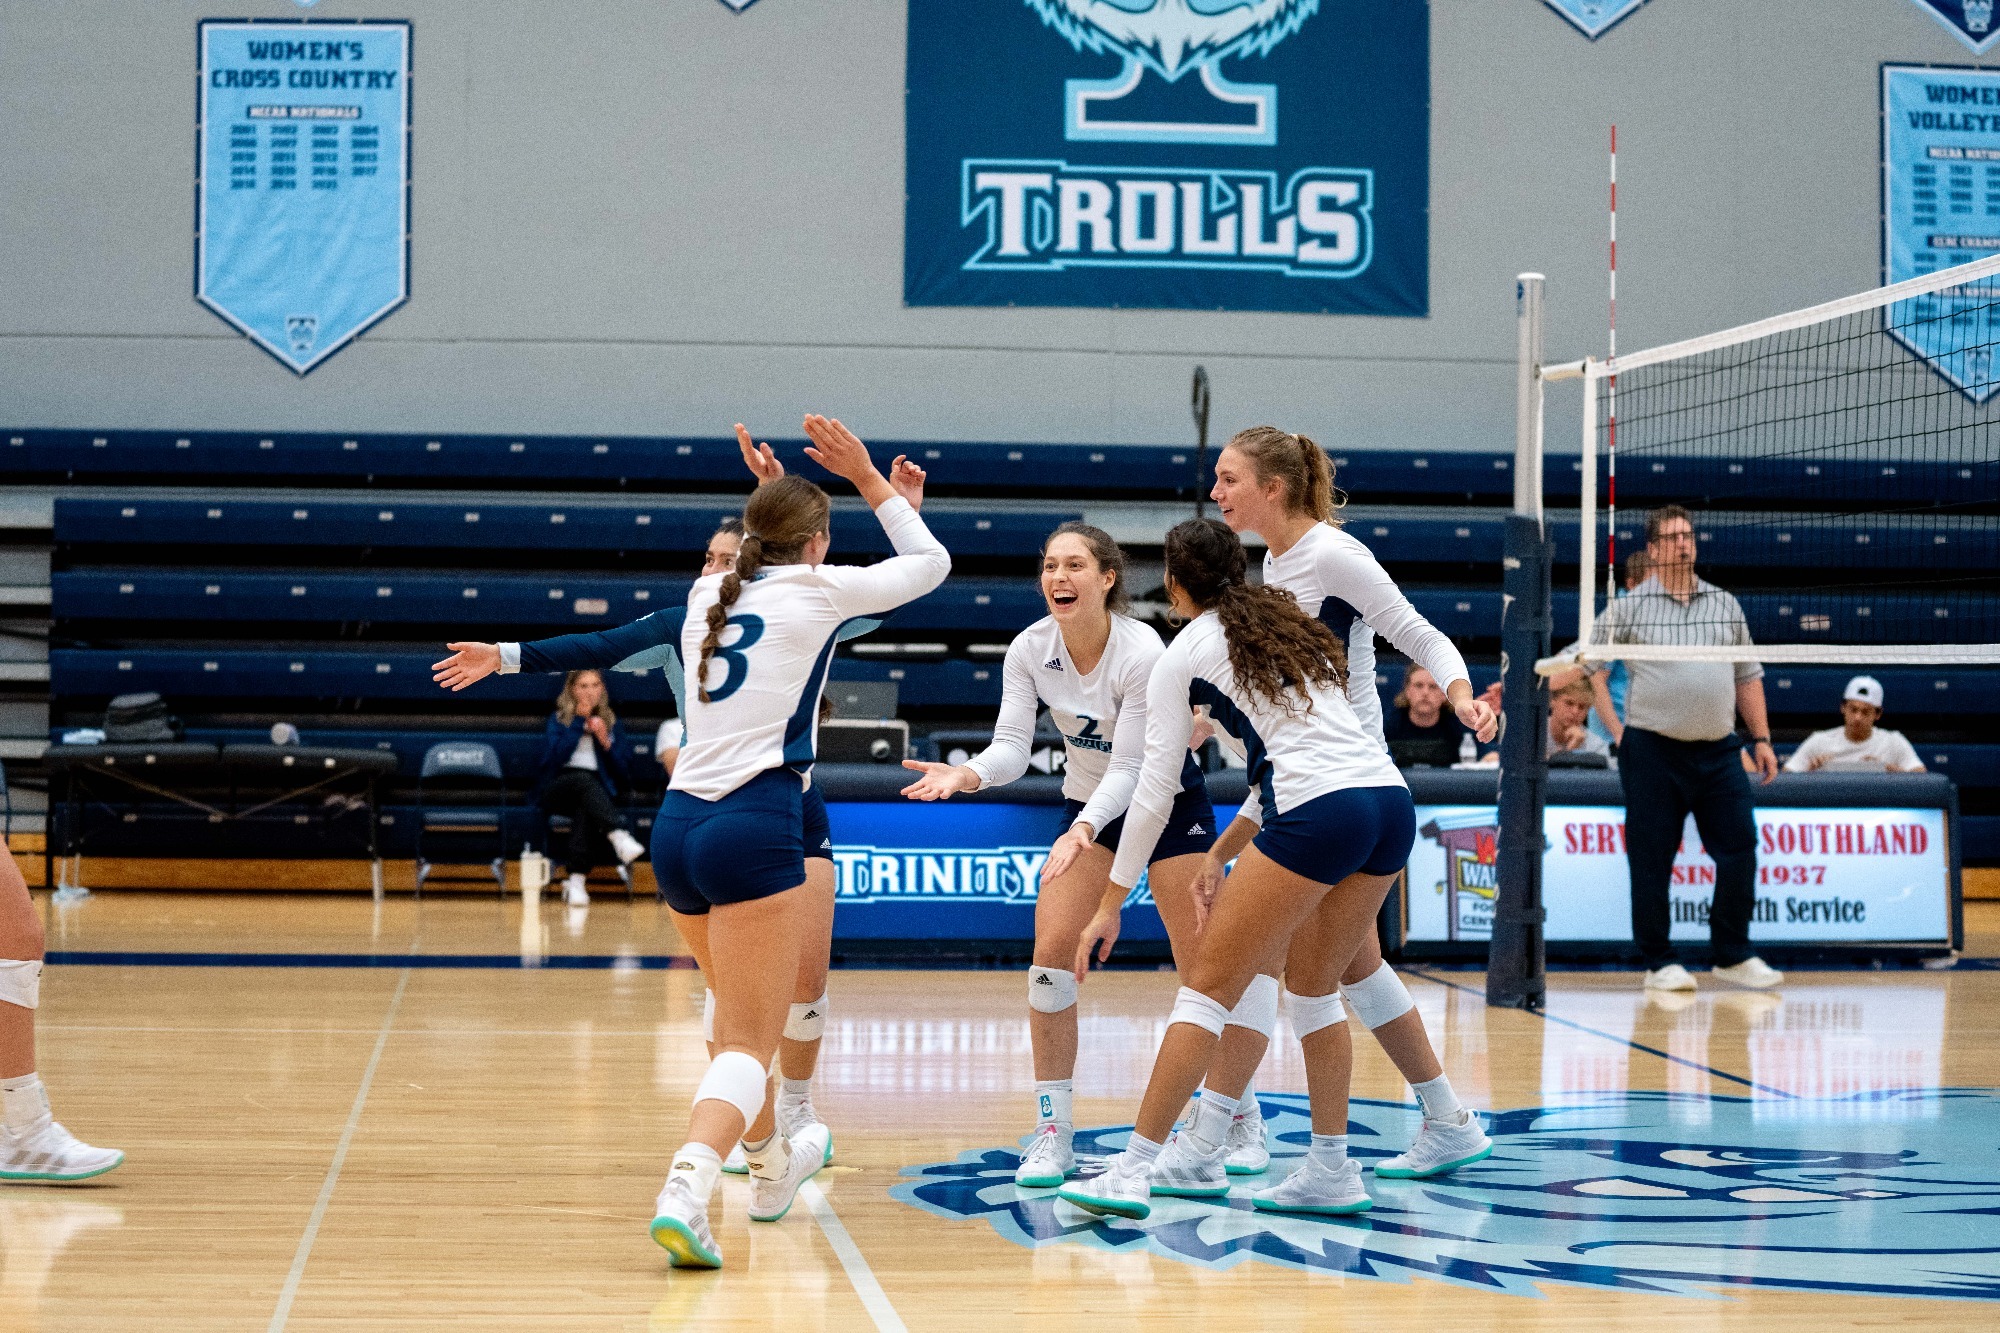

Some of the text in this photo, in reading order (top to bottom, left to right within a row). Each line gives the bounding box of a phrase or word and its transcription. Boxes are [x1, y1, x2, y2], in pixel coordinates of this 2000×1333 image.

[248, 41, 364, 61] WOMEN'S
[212, 70, 397, 89] CROSS COUNTRY
[974, 172, 1361, 264] TROLLS
[1076, 713, 1102, 740] 2
[1761, 823, 1928, 855] SOUTHLAND
[833, 852, 1049, 897] TRINITY
[1759, 865, 1827, 885] 1937
[1786, 896, 1866, 923] Service
